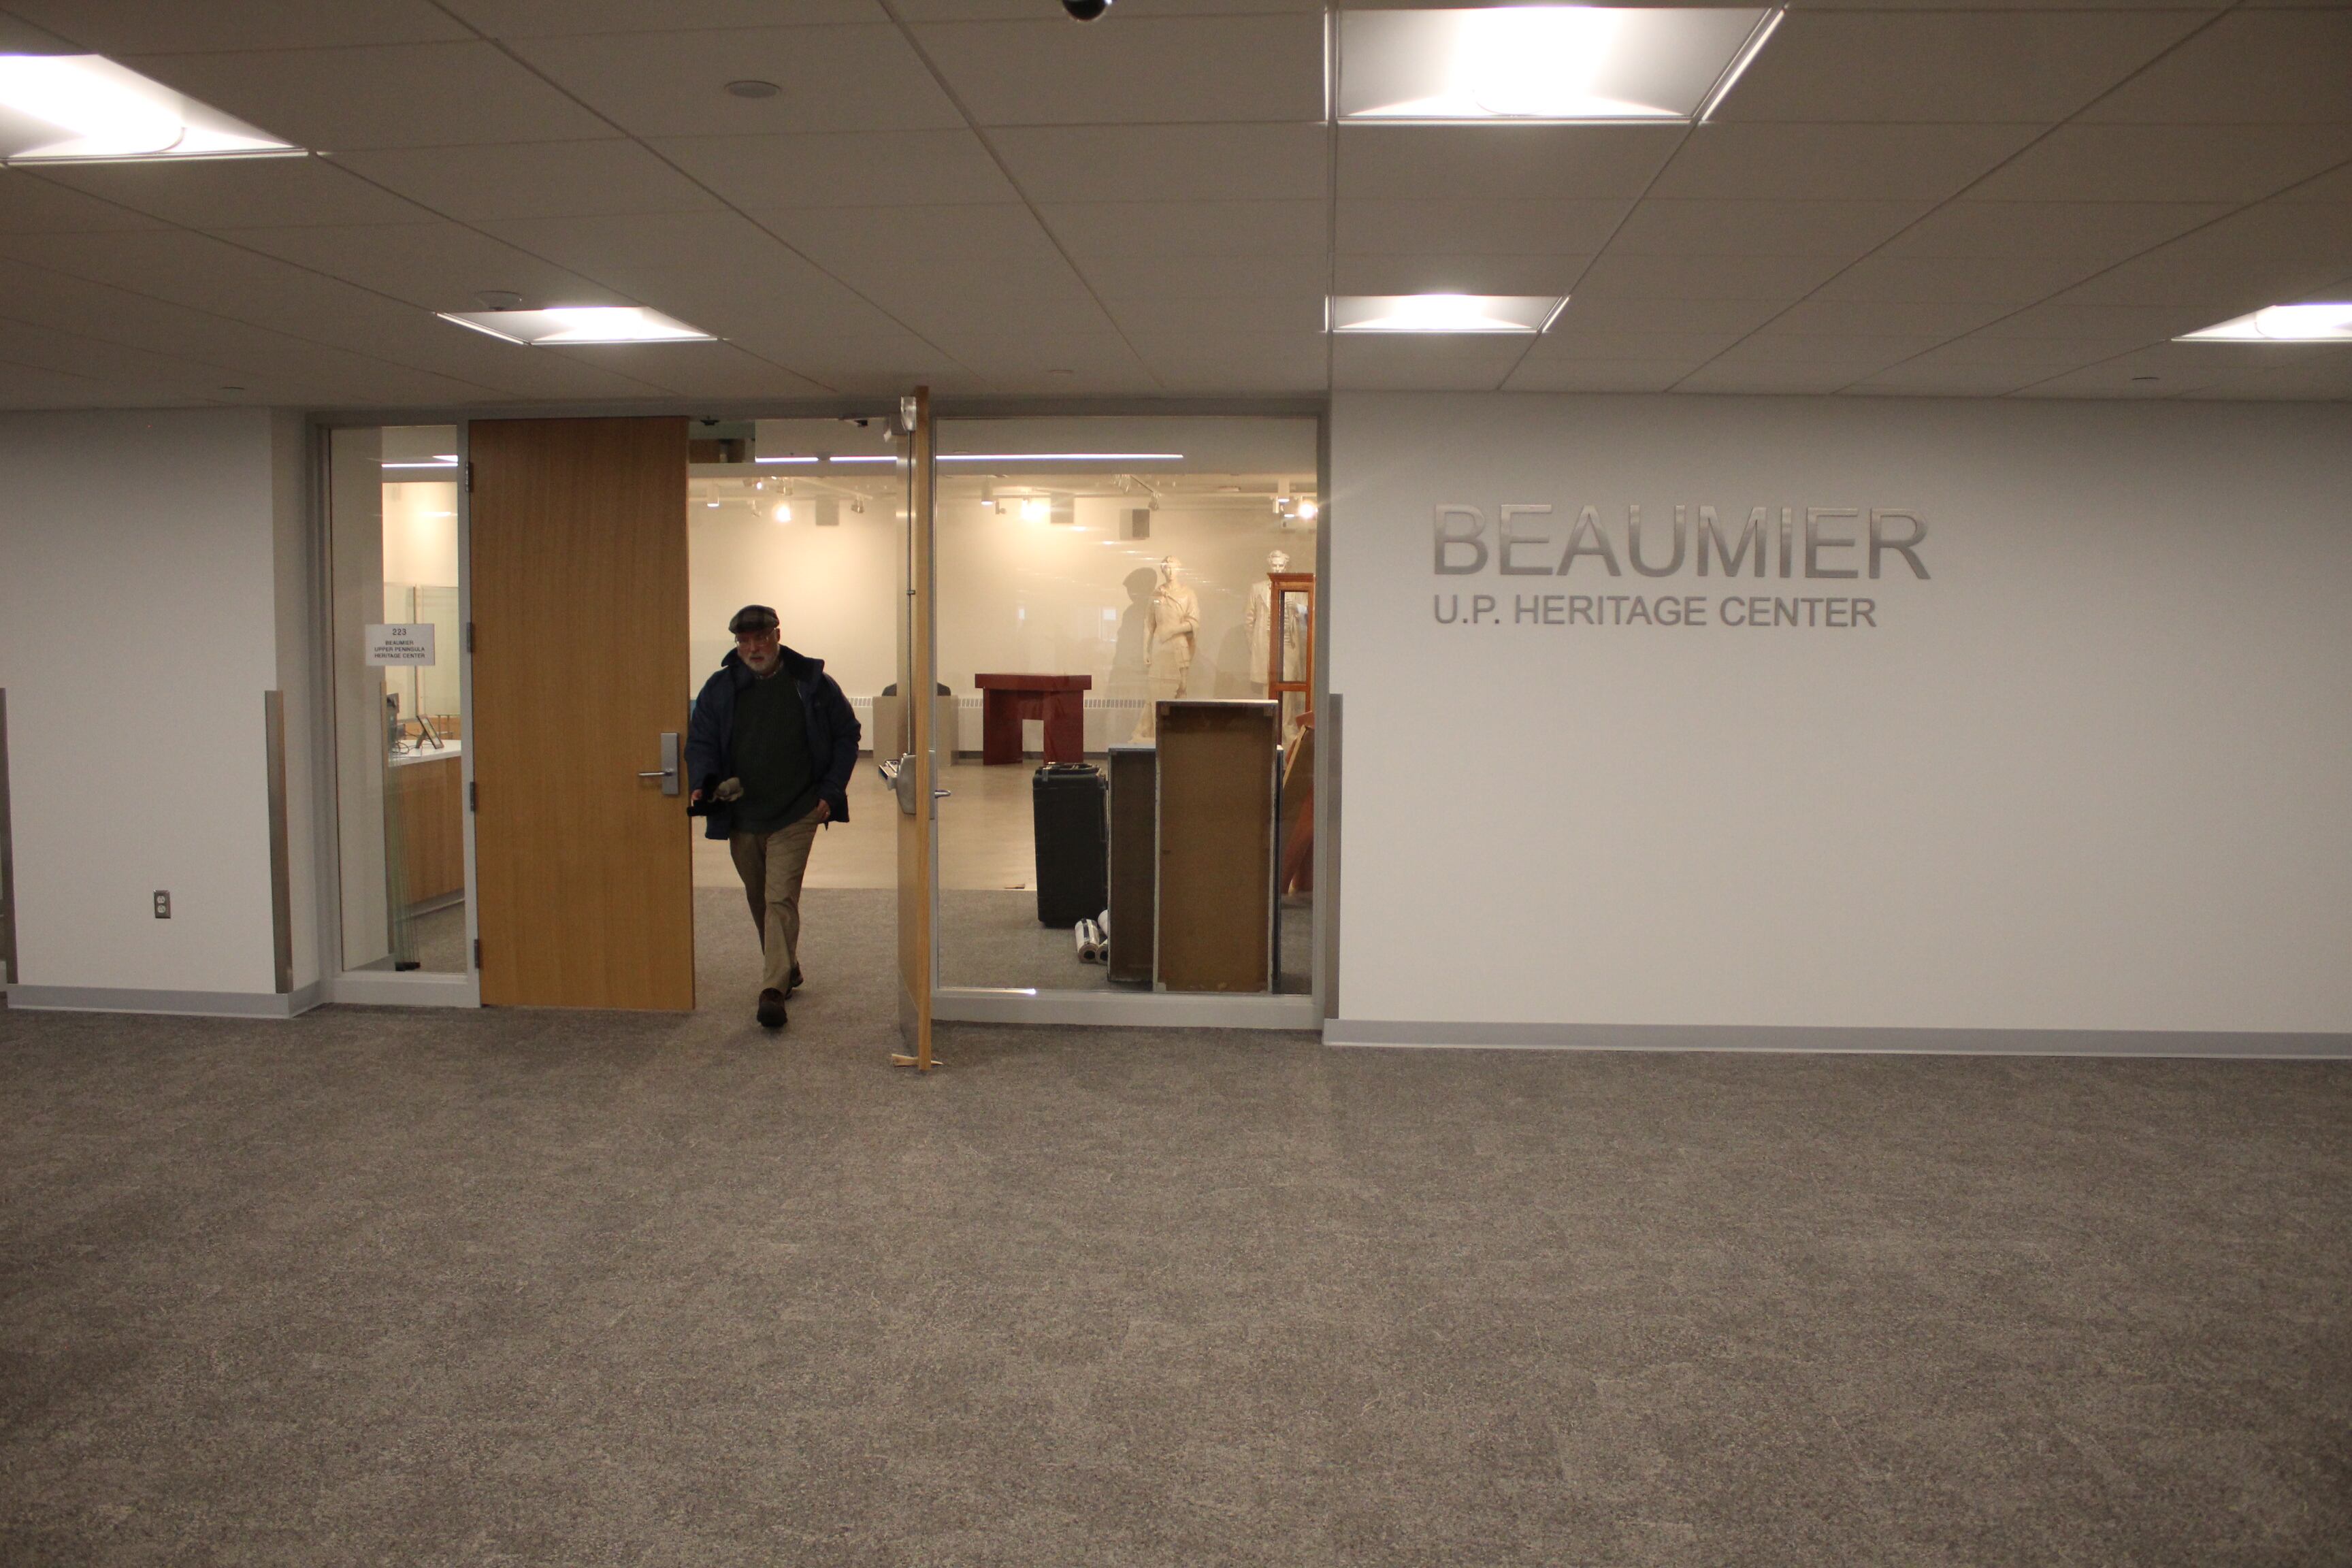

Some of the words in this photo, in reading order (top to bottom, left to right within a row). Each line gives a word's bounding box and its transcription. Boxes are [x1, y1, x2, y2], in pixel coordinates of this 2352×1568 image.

[1433, 504, 1931, 581] BEAUMIER
[1433, 594, 1501, 625] U.P.
[1514, 594, 1708, 625] HERITAGE
[1718, 596, 1878, 627] CENTER
